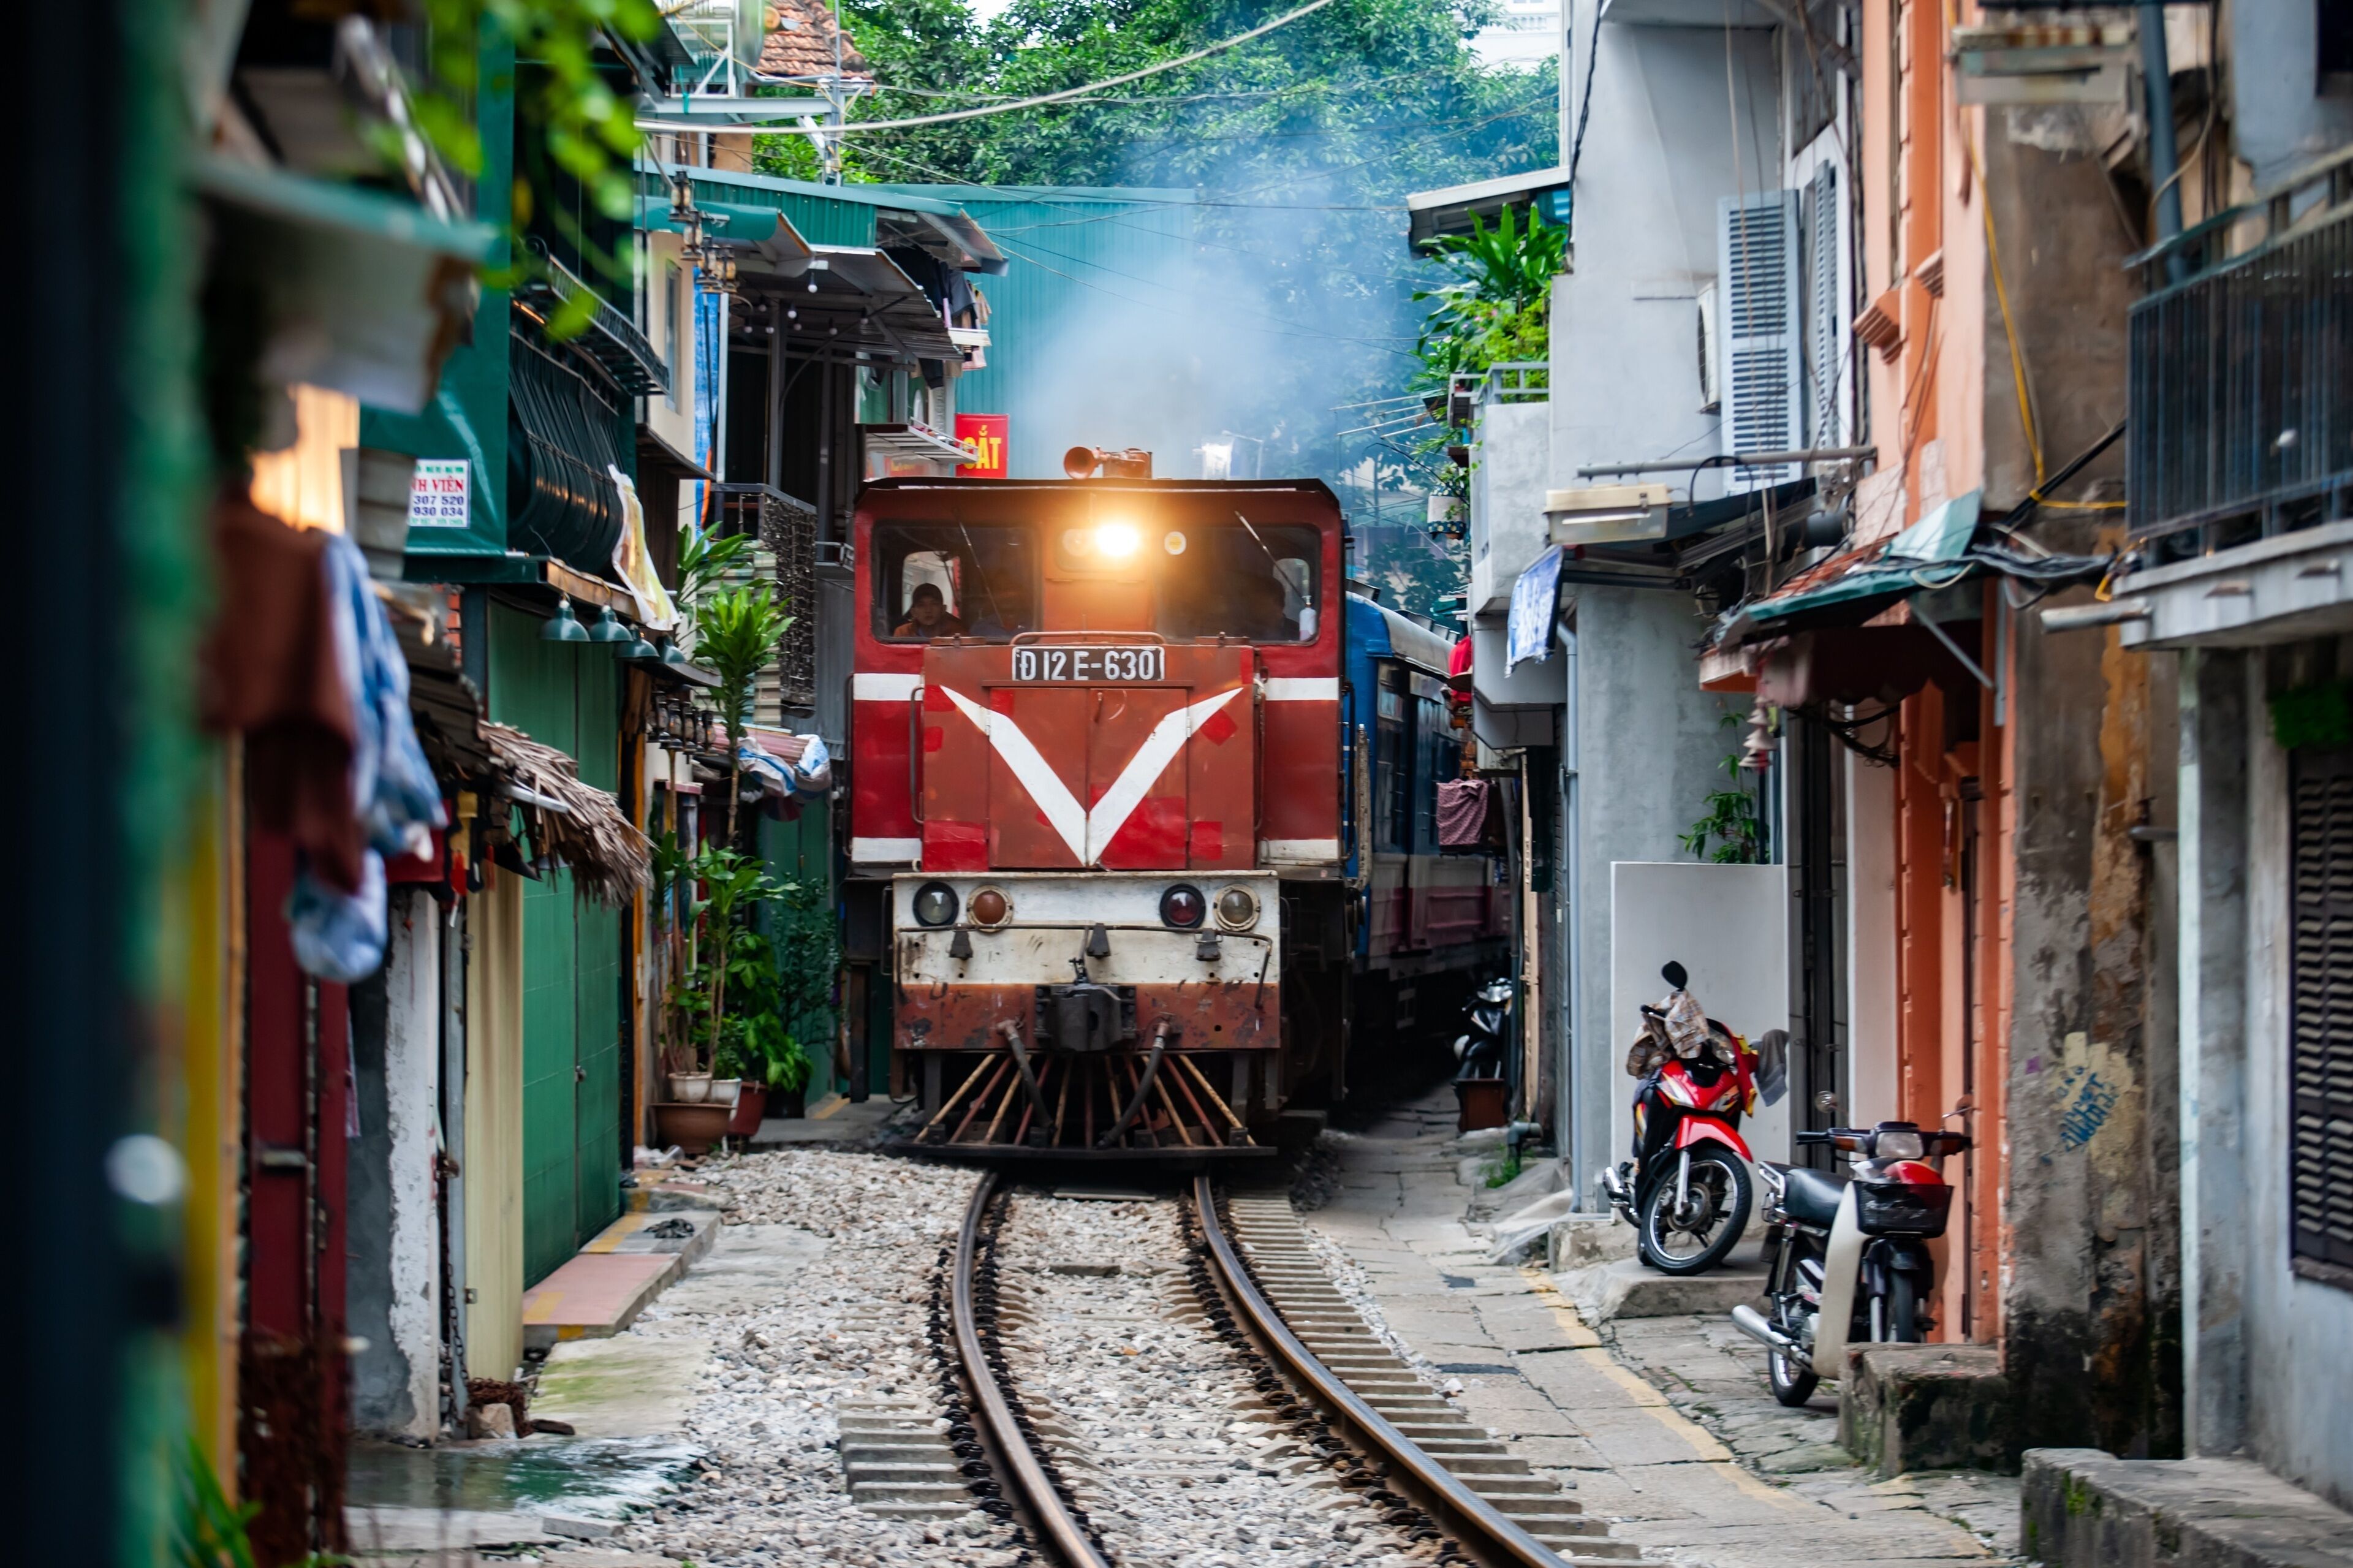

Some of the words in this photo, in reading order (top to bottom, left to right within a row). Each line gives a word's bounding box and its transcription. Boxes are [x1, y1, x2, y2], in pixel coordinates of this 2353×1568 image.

[432, 475, 464, 492] VIÊN
[414, 496, 436, 505] 307
[441, 496, 464, 506] 520
[414, 507, 436, 516] 930
[441, 507, 463, 517] 034
